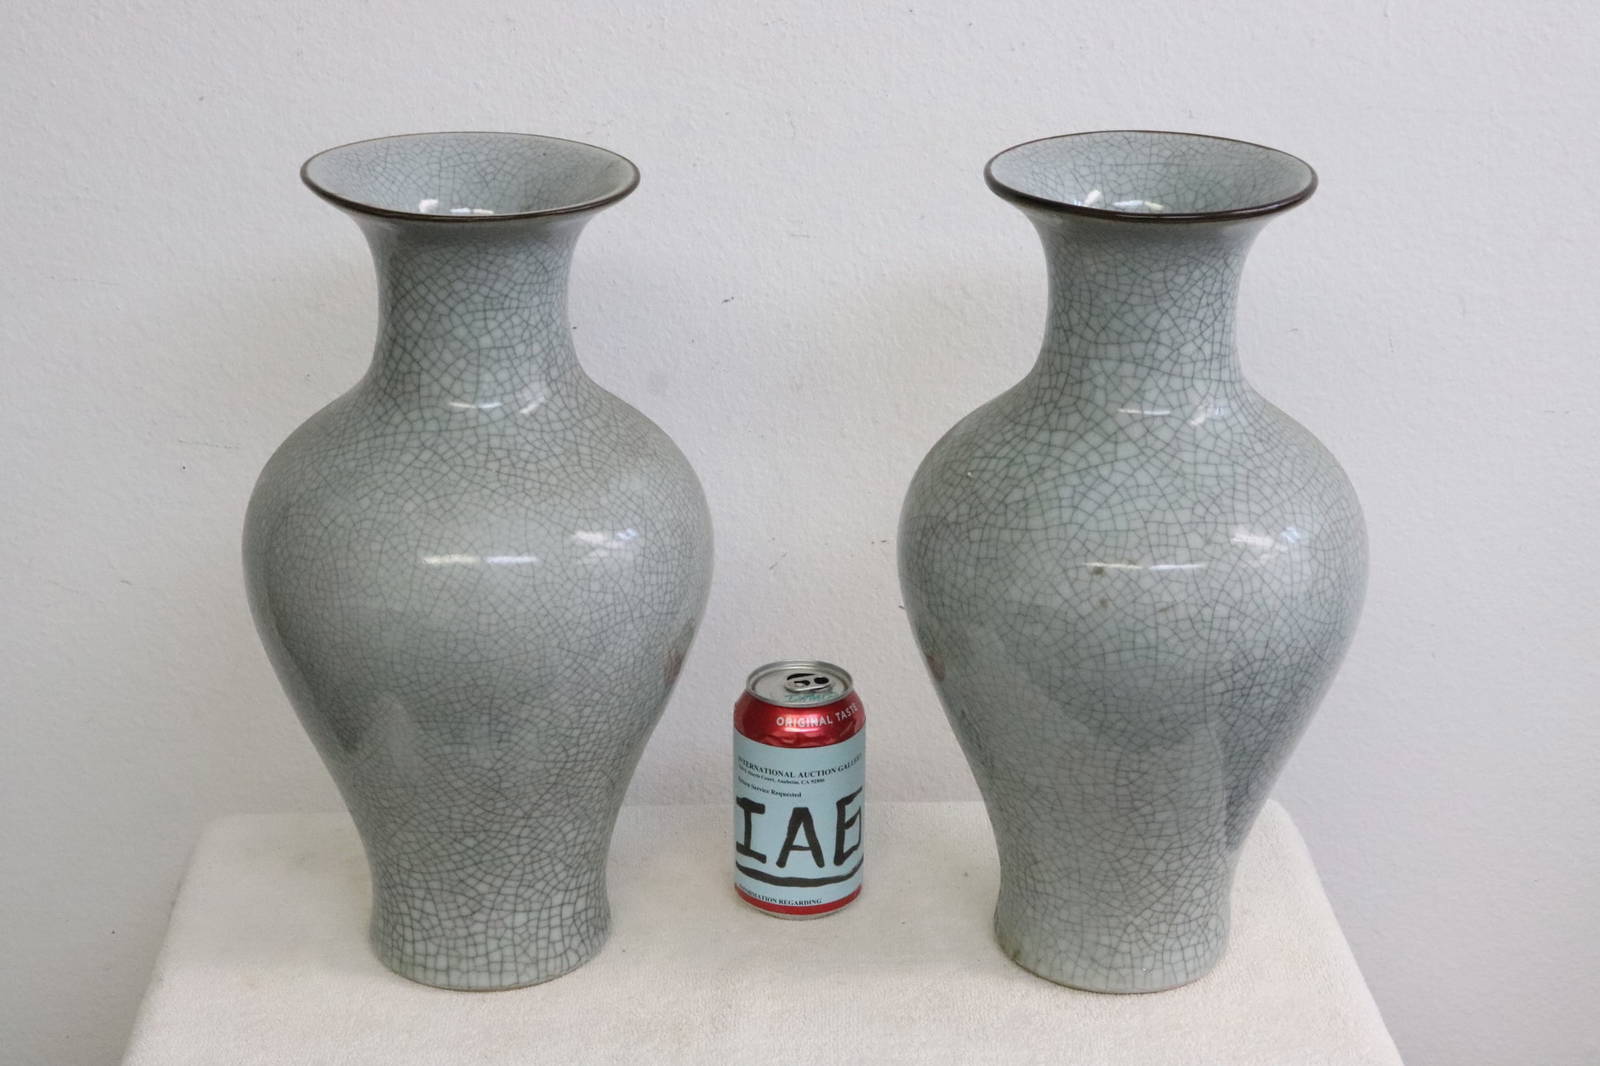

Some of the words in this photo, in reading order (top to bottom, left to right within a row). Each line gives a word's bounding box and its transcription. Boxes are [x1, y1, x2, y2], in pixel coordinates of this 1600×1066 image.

[776, 715, 833, 728] ORIGINAL
[835, 703, 859, 722] TASTE
[798, 768, 836, 778] AUCTION
[771, 789, 802, 798] Requested
[736, 786, 863, 869] IAE
[778, 898, 823, 906] REGARDING
